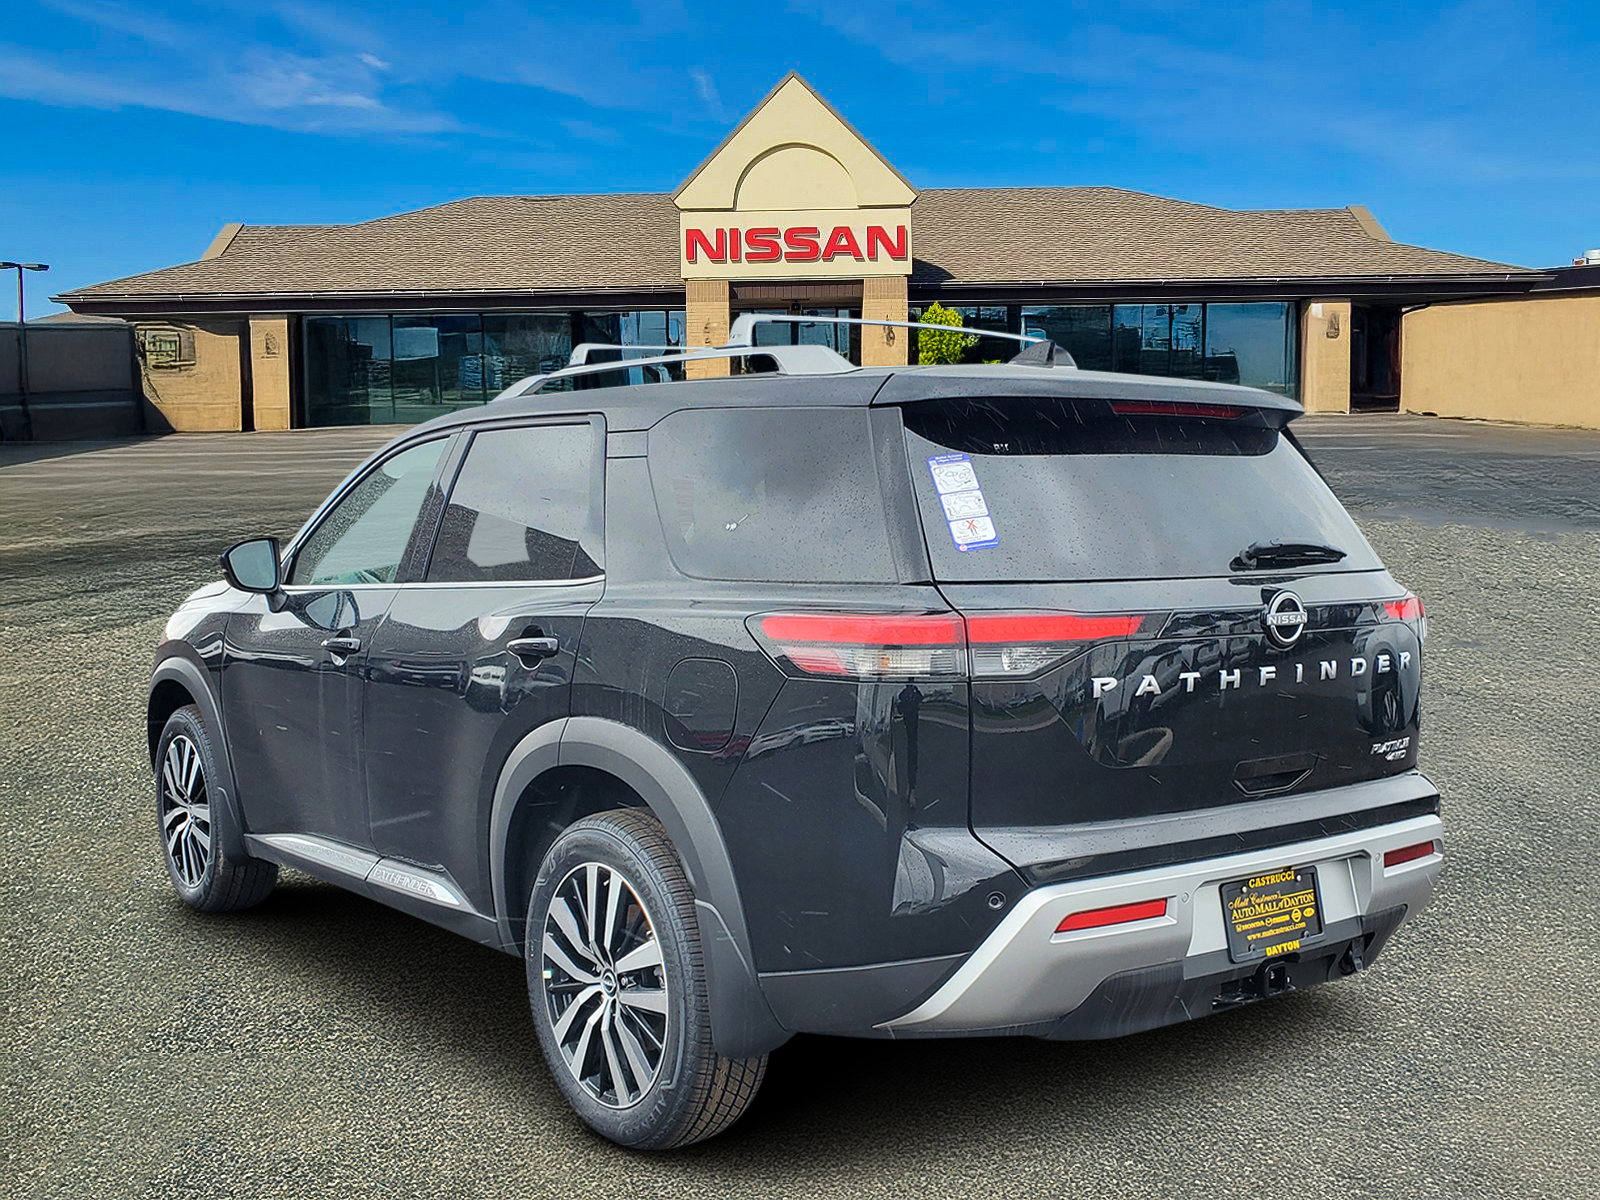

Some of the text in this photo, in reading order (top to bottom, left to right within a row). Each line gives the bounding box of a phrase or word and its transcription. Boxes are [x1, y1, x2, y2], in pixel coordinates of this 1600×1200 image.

[685, 225, 907, 263] NISSAN
[1268, 613, 1307, 625] NISSAN
[1091, 651, 1413, 698] PATHFINDER
[372, 867, 435, 895] PATHFINDER
[1248, 871, 1295, 888] CASTRUCCI
[1231, 906, 1255, 920] AUTO
[1255, 902, 1279, 914] MALL
[1282, 893, 1314, 908] DAYTON
[1265, 940, 1300, 956] DAYTON
